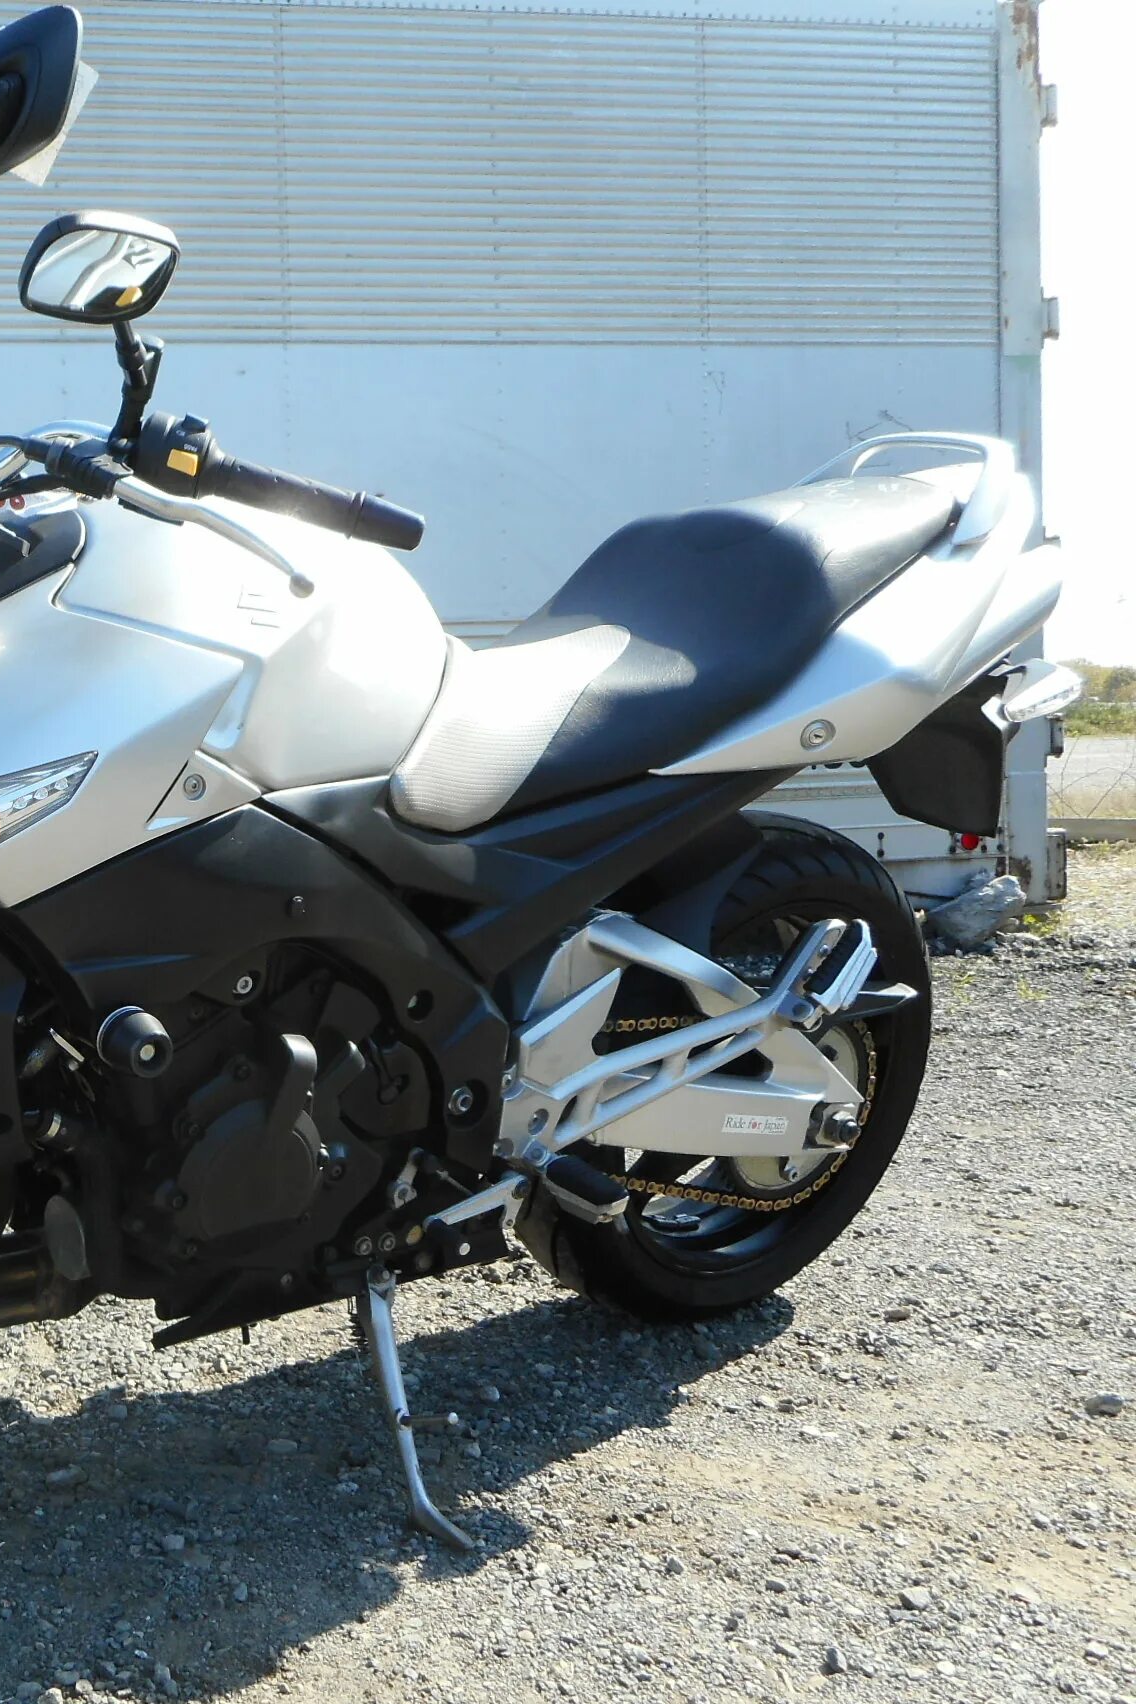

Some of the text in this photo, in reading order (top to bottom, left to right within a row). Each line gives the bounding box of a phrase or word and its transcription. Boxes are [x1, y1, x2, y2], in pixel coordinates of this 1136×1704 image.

[725, 1117, 785, 1133] Ride for Japan
